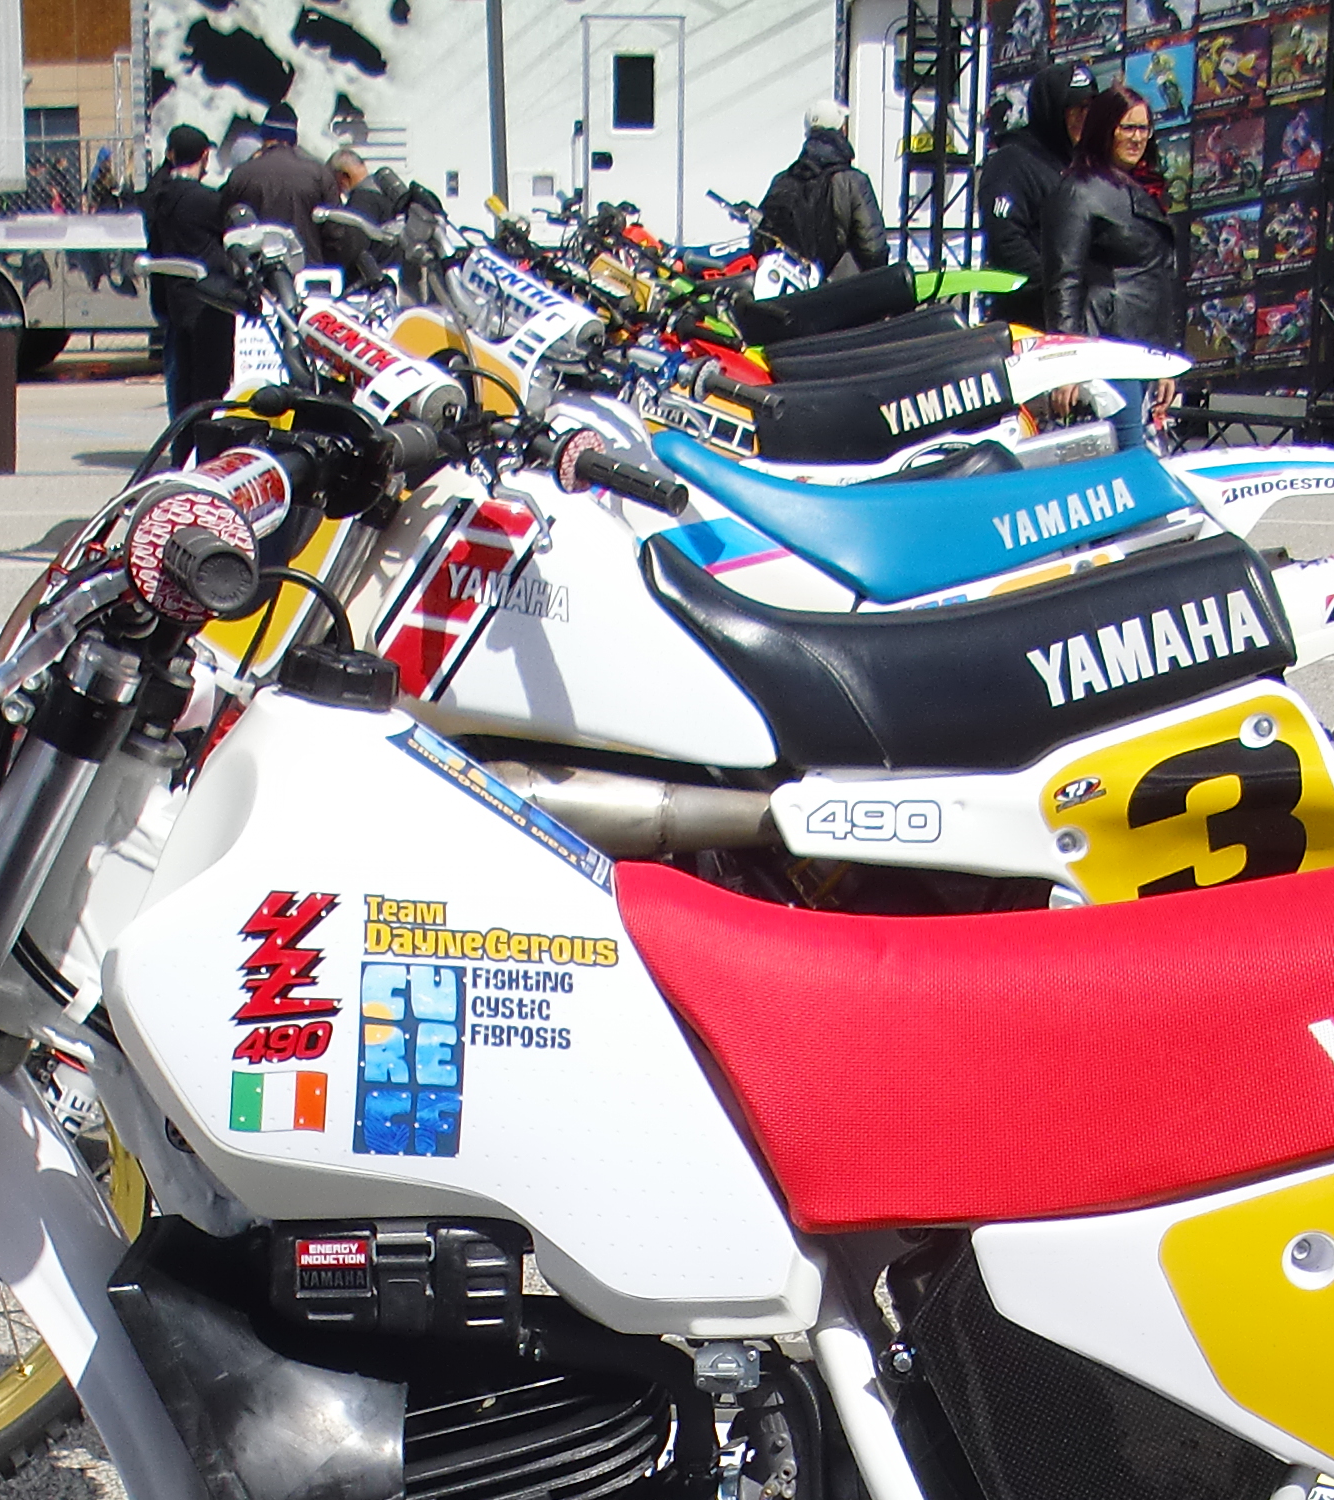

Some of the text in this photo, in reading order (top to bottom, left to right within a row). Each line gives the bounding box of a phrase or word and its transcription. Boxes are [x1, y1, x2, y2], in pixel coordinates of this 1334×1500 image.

[880, 371, 1002, 436] YAMAHA
[992, 477, 1136, 550] YAMAHA
[448, 562, 569, 622] YAMAHA
[1026, 588, 1270, 708] YAMAHA
[806, 799, 942, 844] 490
[1127, 738, 1309, 895] 3
[364, 893, 448, 928] Team
[362, 922, 619, 968] DayneGerous
[232, 1020, 335, 1066] 490
[300, 1253, 366, 1265] INDUCTION
[308, 1242, 359, 1254] ENERGY
[302, 1270, 365, 1287] YAMAHA
